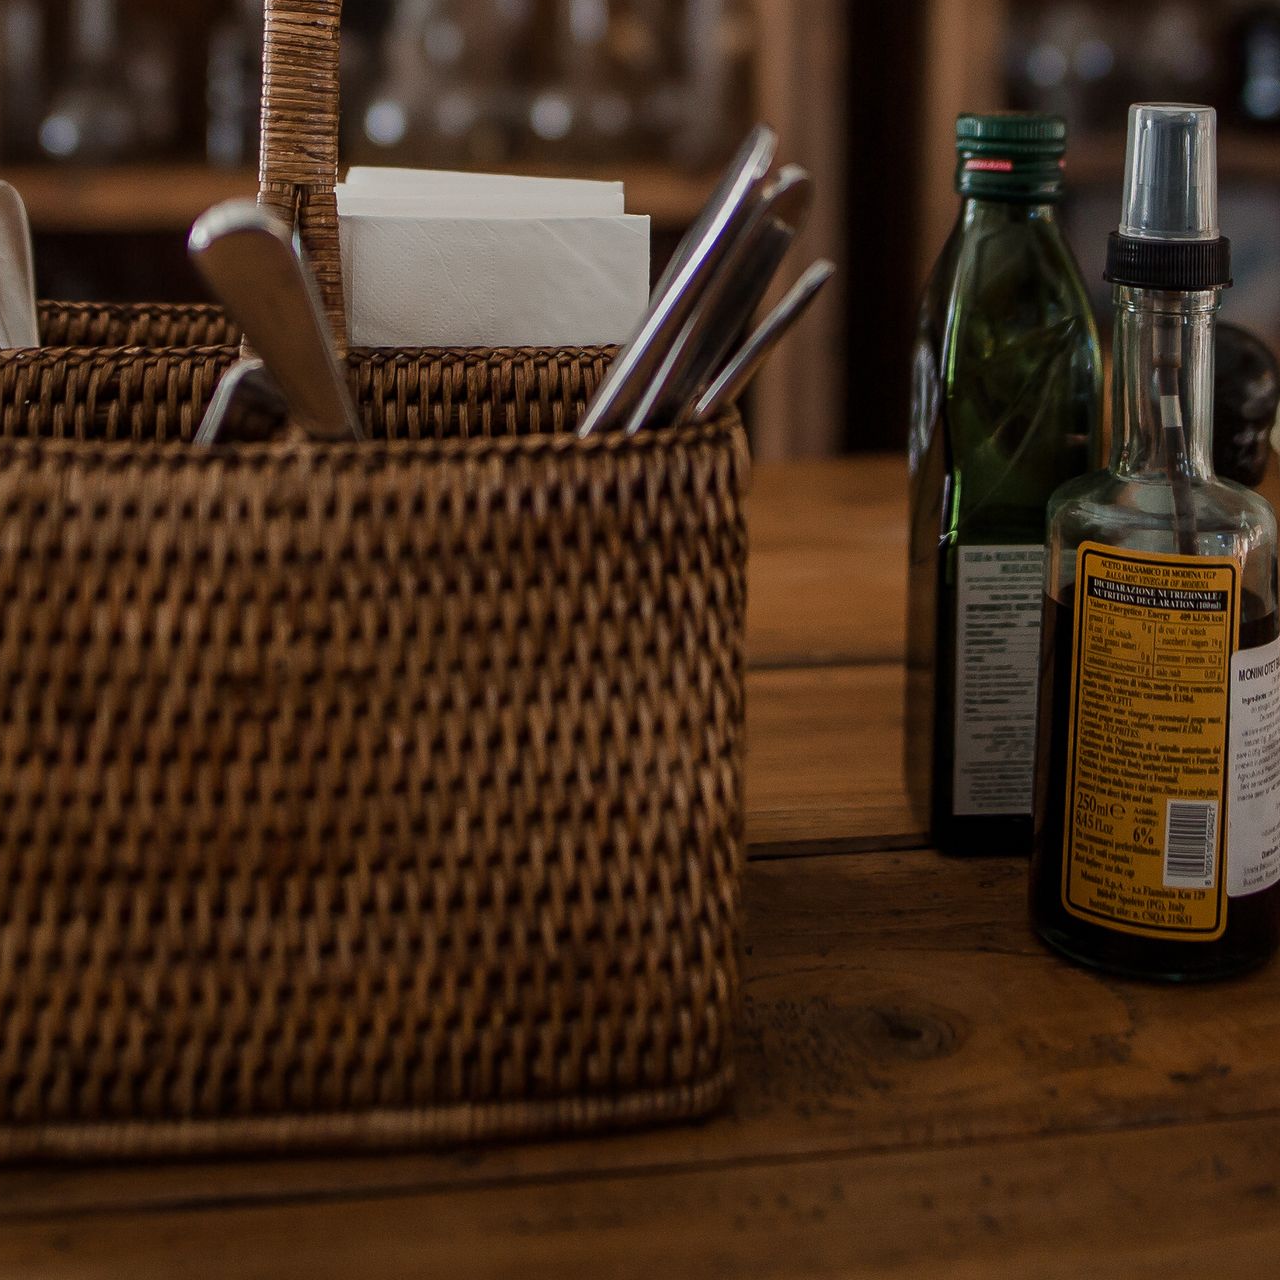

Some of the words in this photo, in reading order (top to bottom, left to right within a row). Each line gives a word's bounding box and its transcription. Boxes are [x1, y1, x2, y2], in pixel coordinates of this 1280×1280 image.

[1101, 560, 1121, 570] ACETO
[1122, 564, 1160, 576] BALSAMICO
[1162, 568, 1170, 577] DI
[1171, 569, 1201, 579] MODENA
[1105, 570, 1138, 582] BALSAMIC
[1139, 576, 1169, 586] VINEGAR
[1093, 578, 1155, 596] DICHIARAZIONE
[1158, 589, 1217, 600] NUTRIZIONALE
[1093, 588, 1135, 603] NUTRITION
[1136, 596, 1195, 608] DECLARATION
[1089, 598, 1107, 609] Valore
[1109, 602, 1142, 616] Energetico
[1147, 608, 1171, 620] Energy
[1238, 664, 1264, 682] MONINI
[1133, 826, 1154, 845] 6%
